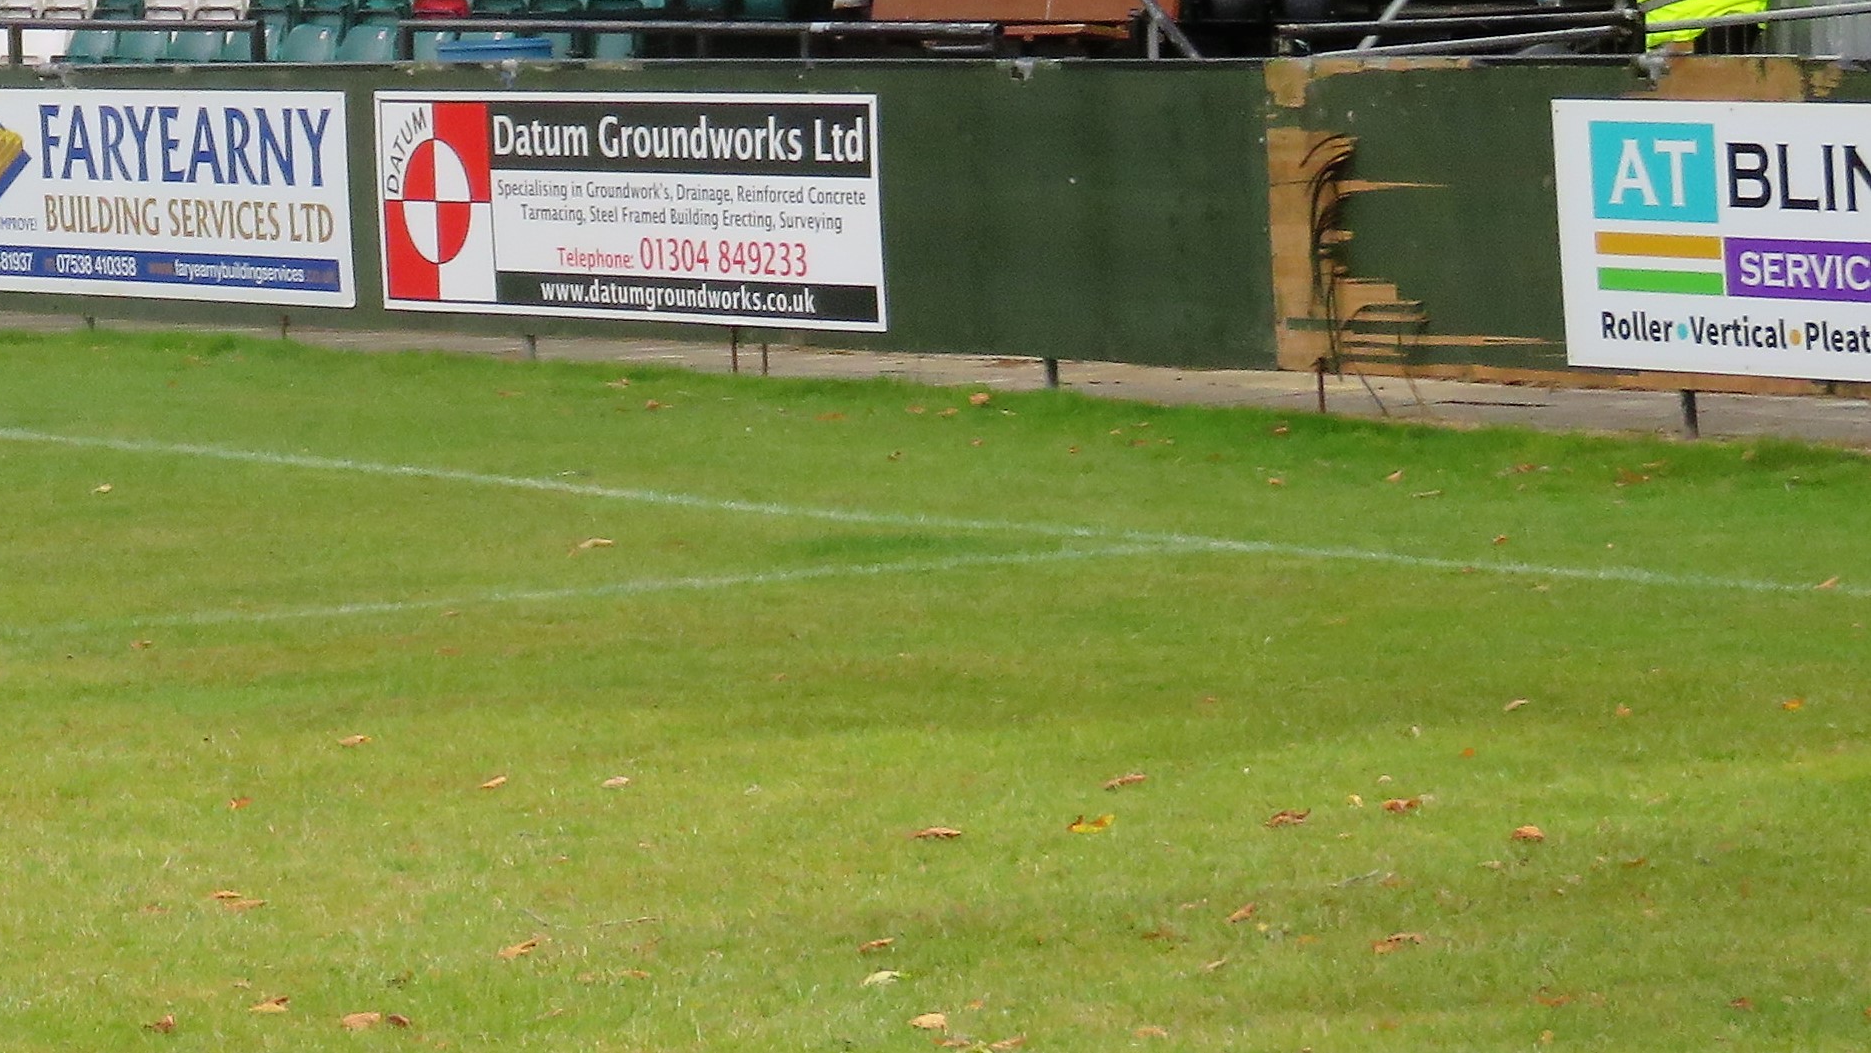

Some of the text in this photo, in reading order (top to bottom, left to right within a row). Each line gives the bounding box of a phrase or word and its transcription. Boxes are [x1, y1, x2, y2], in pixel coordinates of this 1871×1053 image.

[38, 103, 332, 188] FARYEARNY
[386, 106, 429, 195] DATUM
[492, 114, 865, 164] Datum Groundworks Ltd
[497, 178, 867, 206] Specialising in Groundwork's, Drainage, Reinforced Concrete
[1607, 138, 1700, 209] AT
[43, 193, 335, 244] BUILDING SERVICES LTD
[589, 205, 619, 223] Steel
[622, 206, 667, 225] Framed
[670, 207, 719, 231] Building
[722, 209, 776, 233] Erecting,
[779, 210, 843, 235] Surveying
[55, 253, 93, 276] 07538
[94, 255, 137, 278] 410358
[556, 236, 809, 278] Telephone: 01304 849233
[540, 279, 817, 316] www.datumgroundworks.co.uk
[1601, 310, 1675, 343] Roller
[1687, 315, 1788, 351] Vertical
